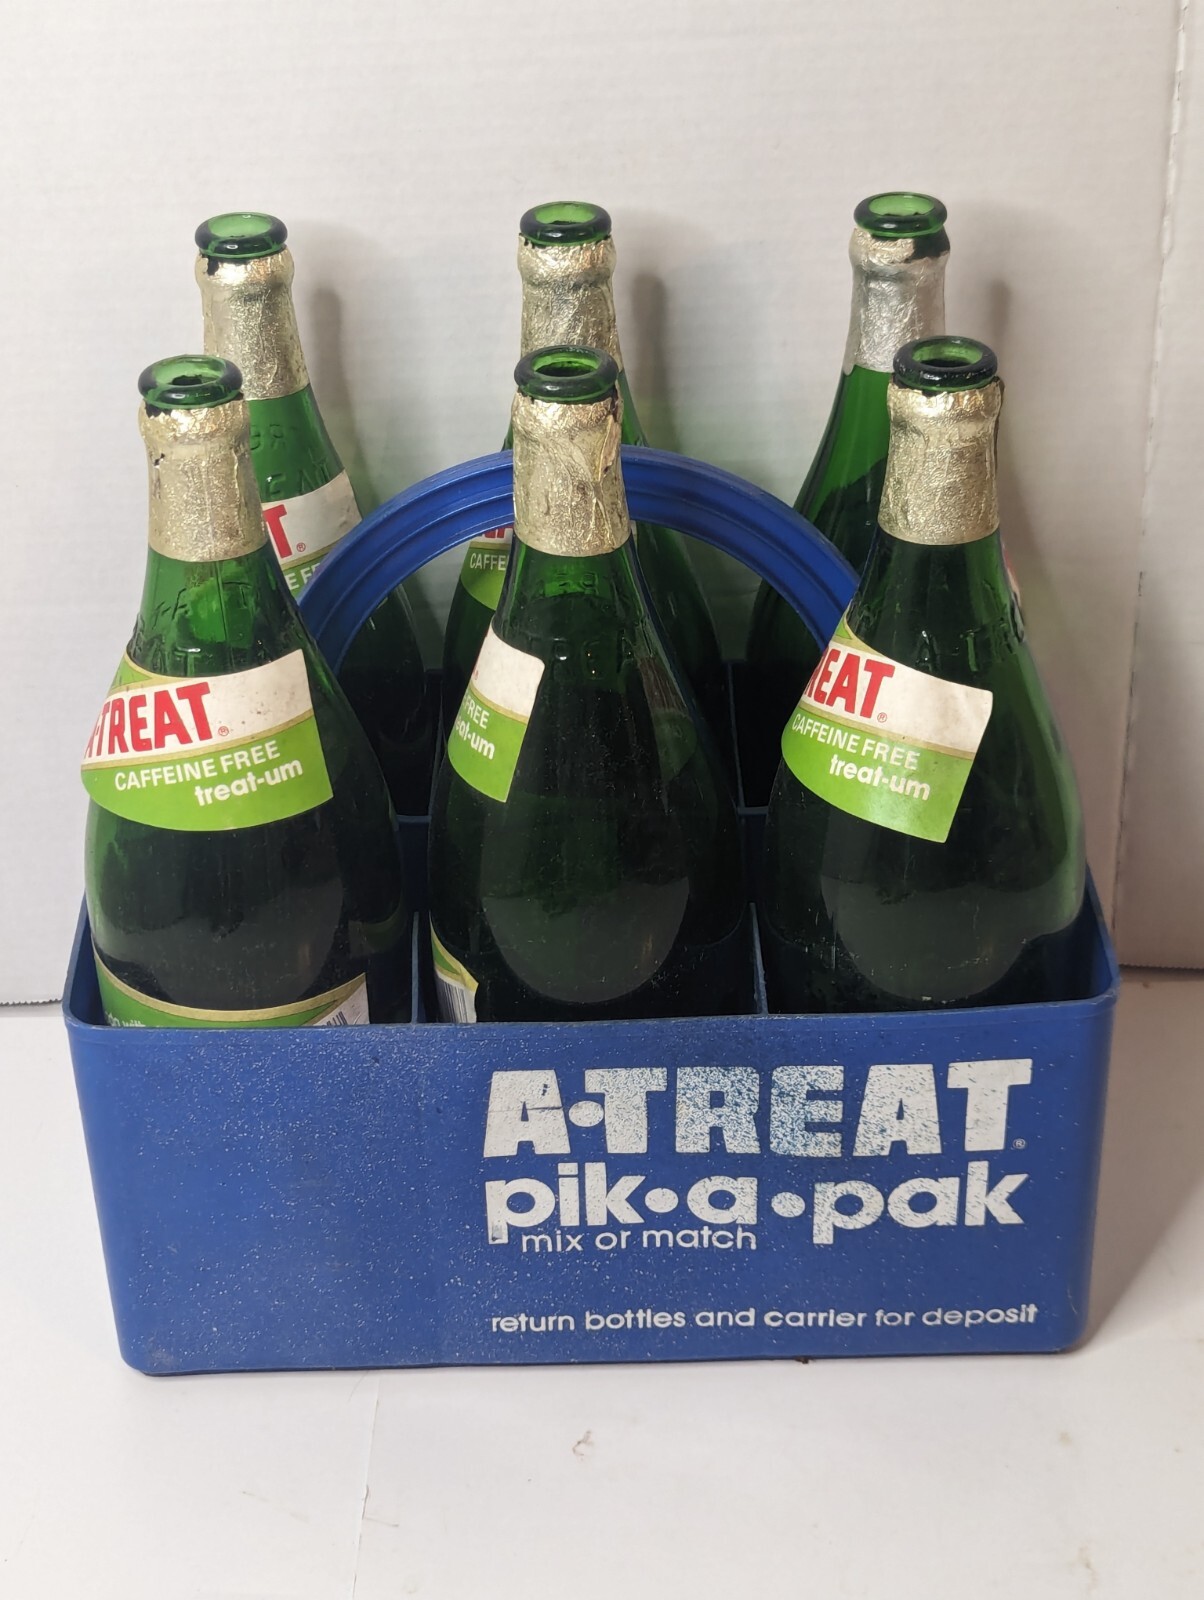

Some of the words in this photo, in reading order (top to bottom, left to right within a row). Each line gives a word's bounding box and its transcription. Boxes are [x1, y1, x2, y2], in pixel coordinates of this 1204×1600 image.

[469, 552, 509, 571] CAFFE
[791, 712, 861, 754] CAFFEINE
[861, 737, 921, 771] FREE
[114, 758, 218, 791] CAFFEINE
[220, 740, 281, 774] FREE
[194, 758, 303, 806] treat-um
[828, 754, 931, 801] treat-um
[521, 1229, 584, 1253] mix
[594, 1230, 631, 1250] or
[642, 1225, 757, 1250] match
[491, 1312, 575, 1333] return
[585, 1308, 687, 1330] bottles
[694, 1307, 756, 1329] and
[763, 1307, 867, 1328] carrier
[874, 1308, 915, 1327] for
[921, 1303, 1039, 1329] deposit
